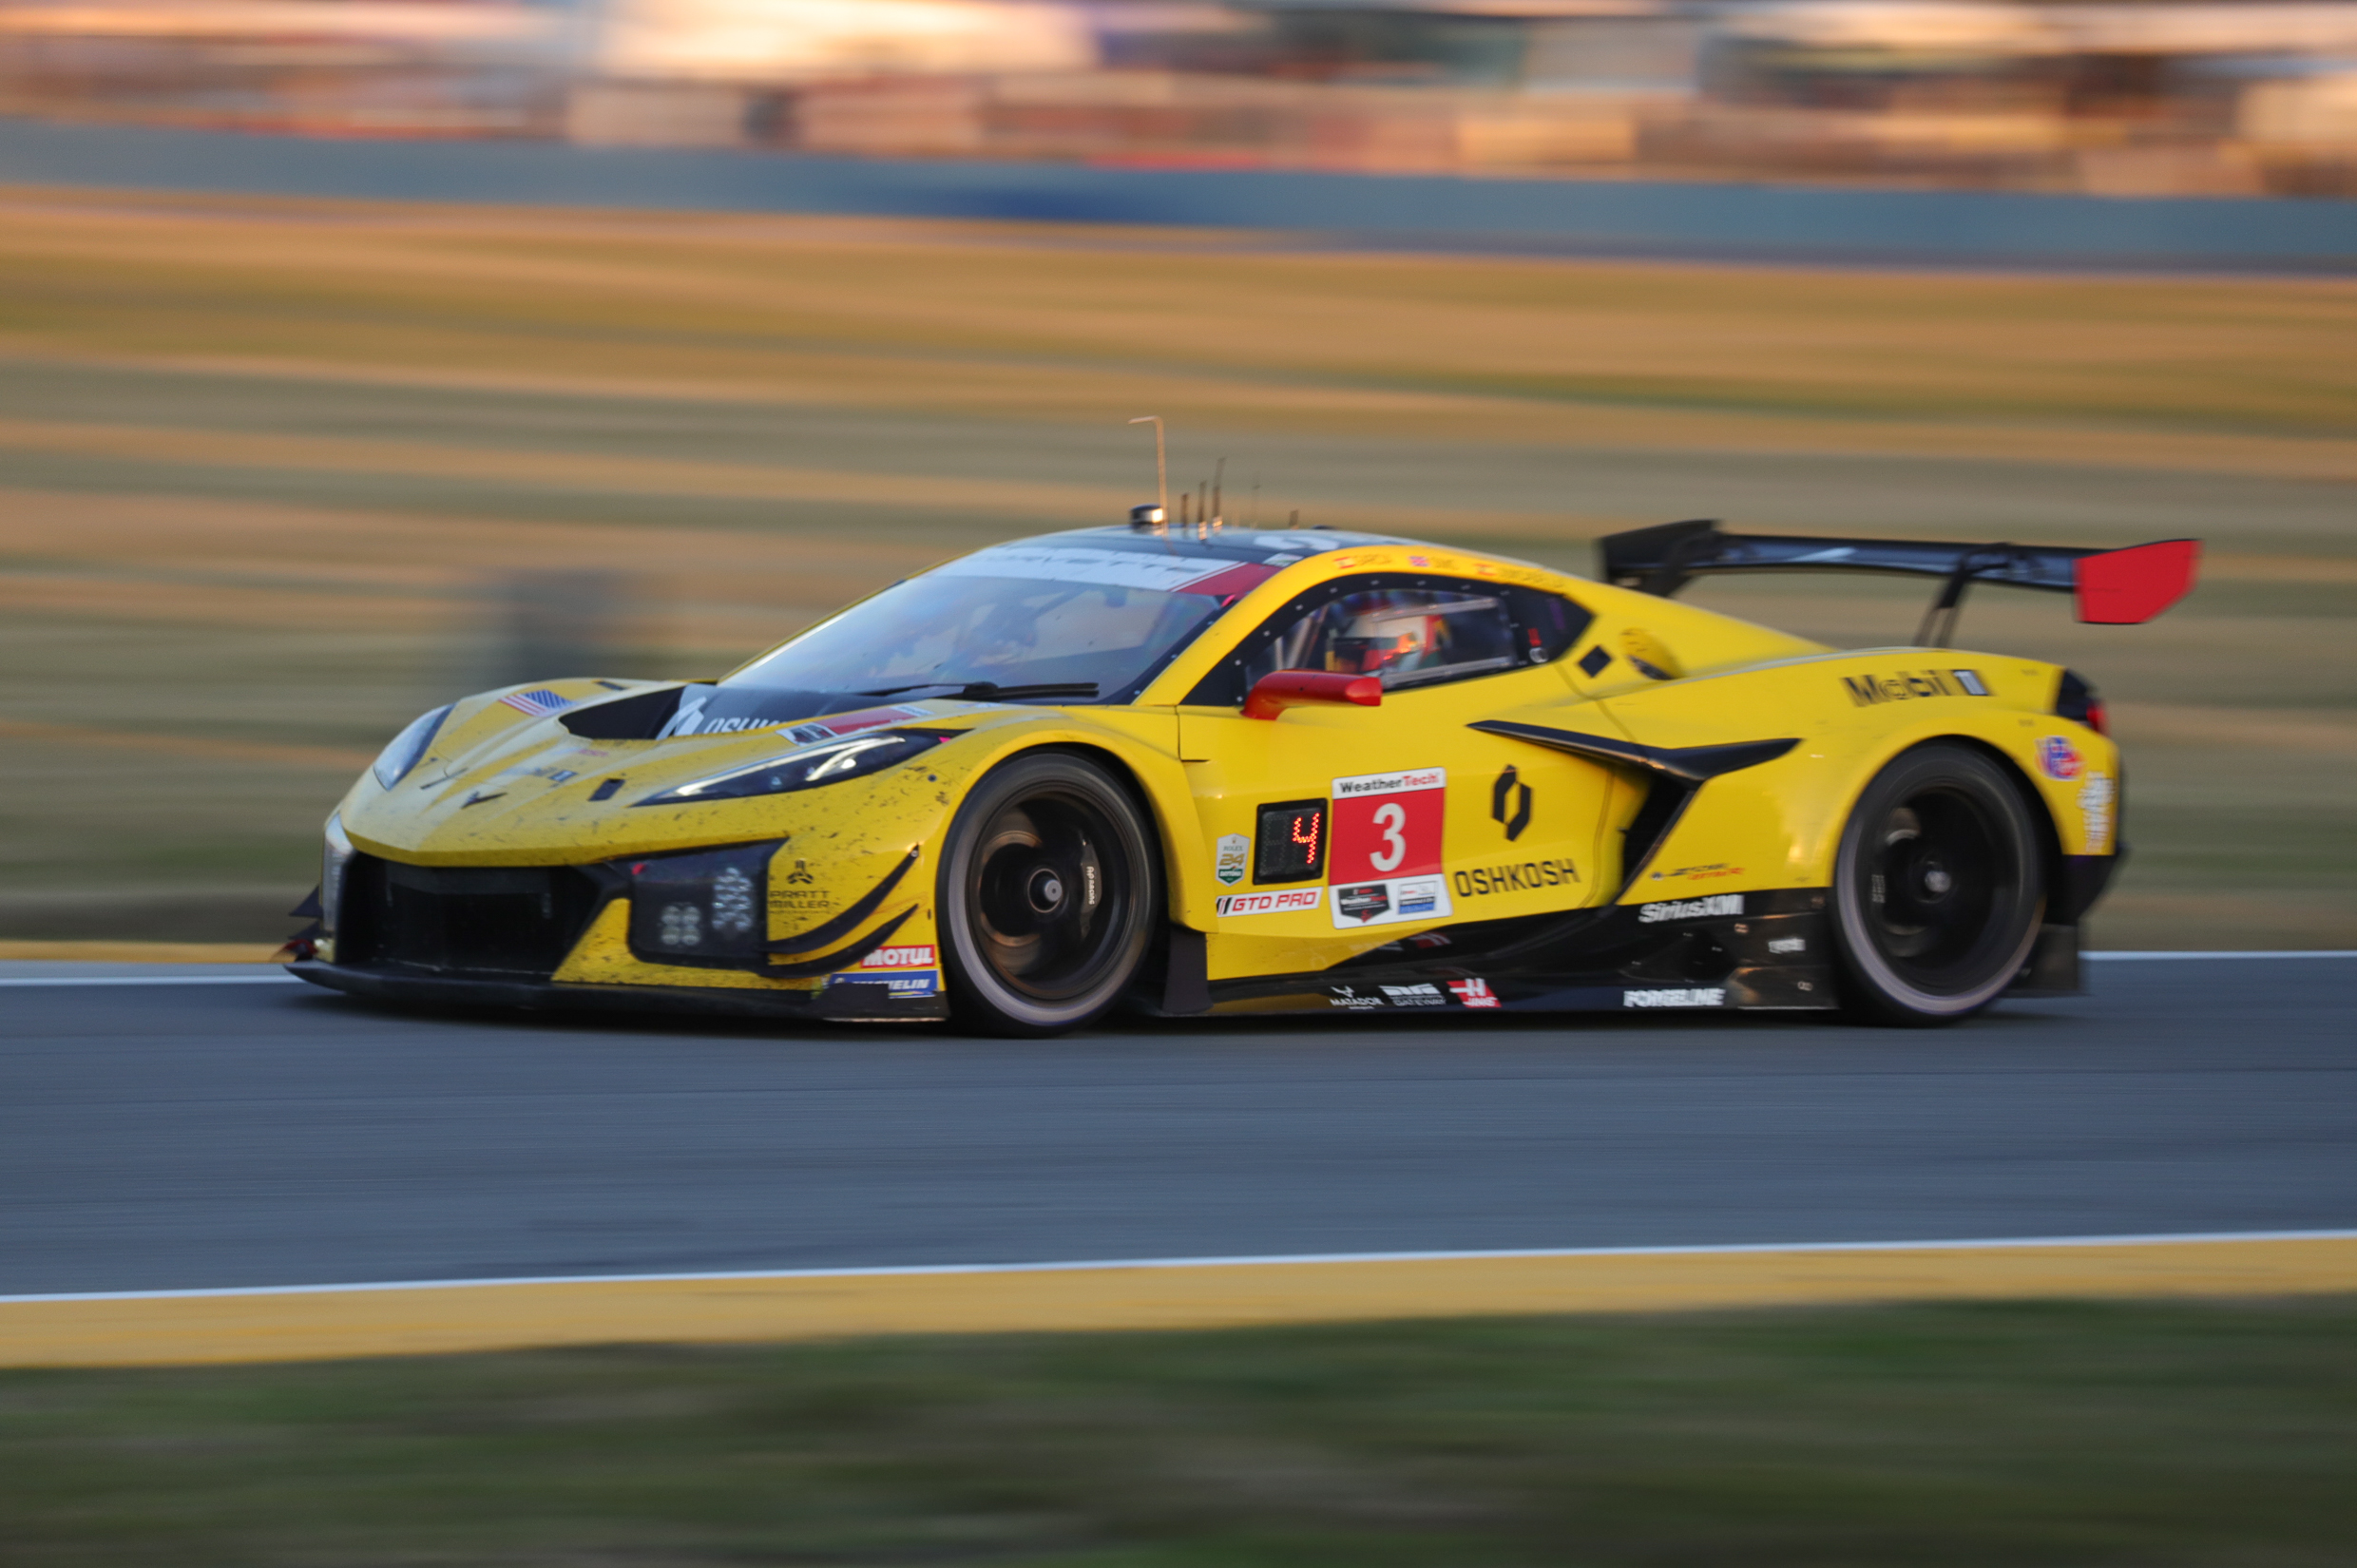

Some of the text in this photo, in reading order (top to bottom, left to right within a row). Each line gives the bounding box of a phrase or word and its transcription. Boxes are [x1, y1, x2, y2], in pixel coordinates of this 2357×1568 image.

[1842, 670, 1952, 707] Mobil
[1340, 774, 1439, 794] WeatherTech
[1293, 813, 1320, 864] 4
[1370, 802, 1406, 871] 3
[1219, 853, 1245, 866] 24
[1454, 857, 1581, 897] OSHKOSH
[769, 900, 830, 908] MILLER
[1232, 891, 1317, 911] GTD PRO
[863, 947, 934, 966] MOTUL
